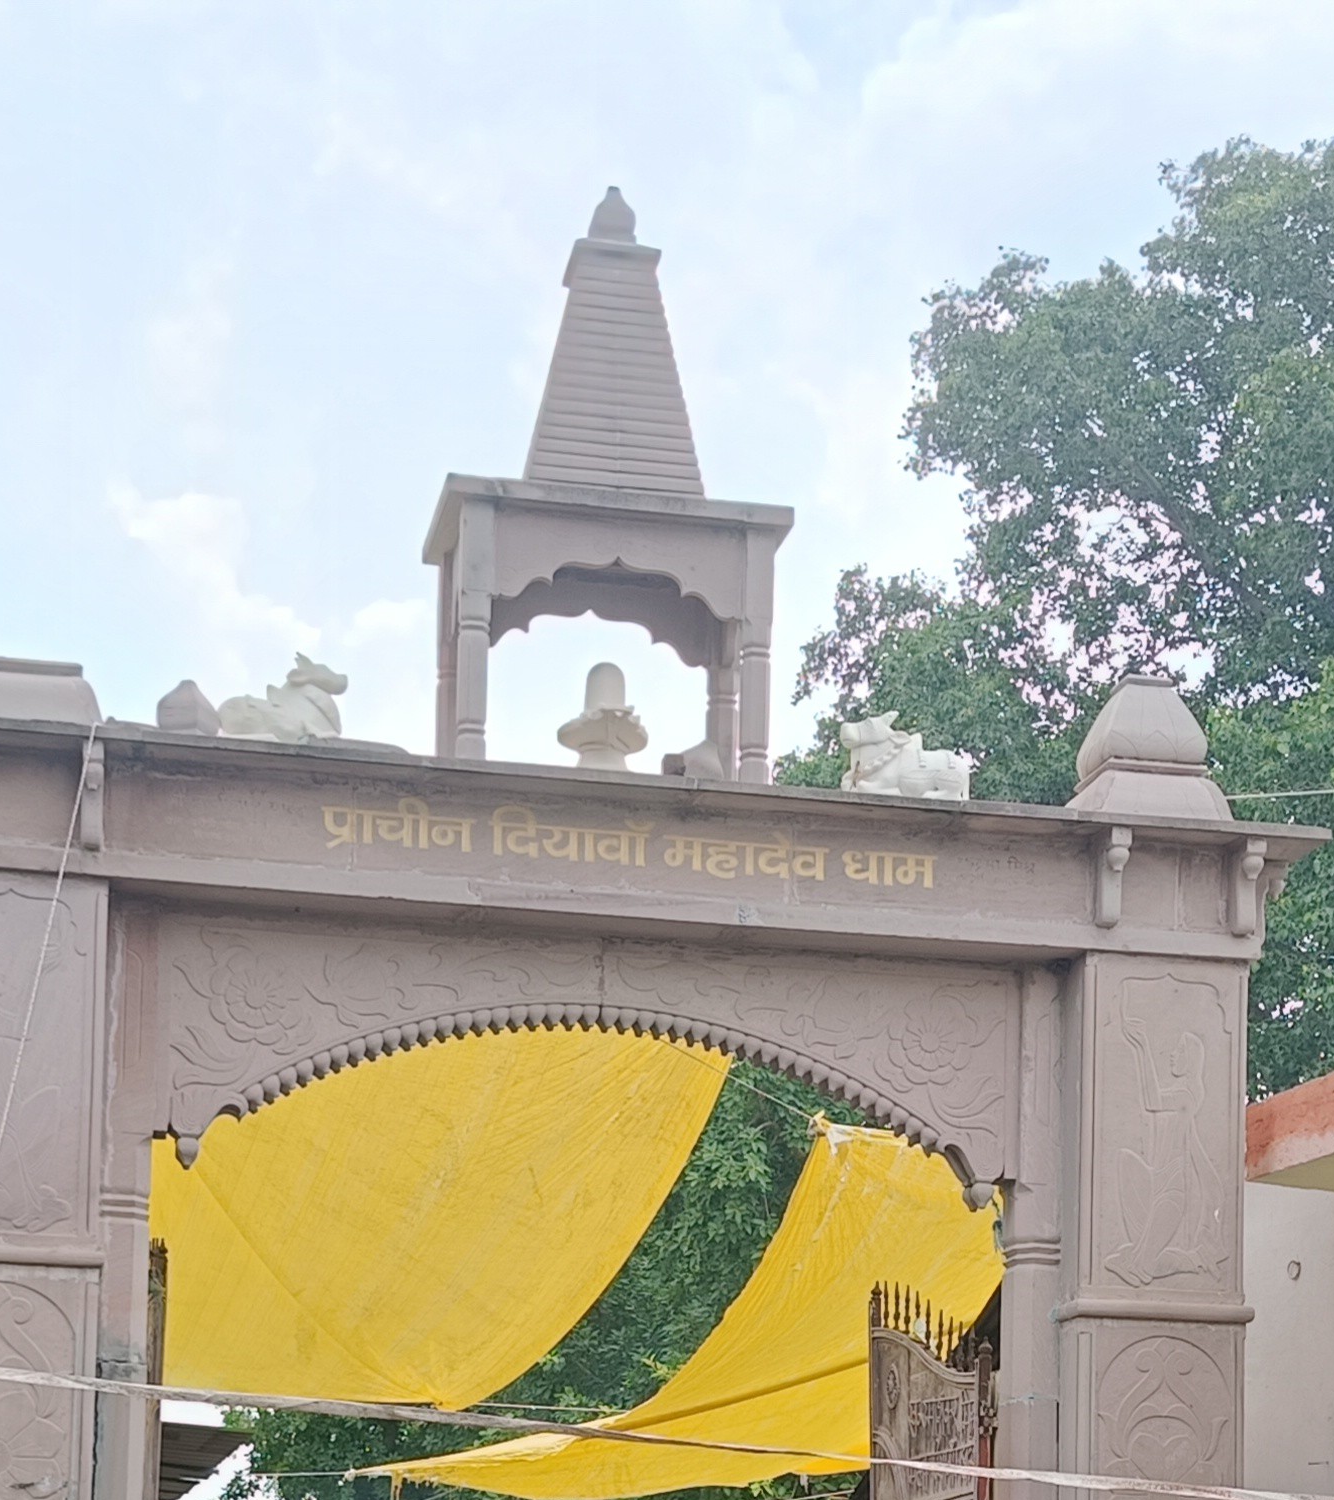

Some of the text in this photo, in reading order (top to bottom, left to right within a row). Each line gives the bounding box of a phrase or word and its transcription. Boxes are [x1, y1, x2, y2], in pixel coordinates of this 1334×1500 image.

[322, 798, 476, 853] प्राचीन
[664, 831, 829, 881] महादेव
[841, 849, 938, 889] धाम
